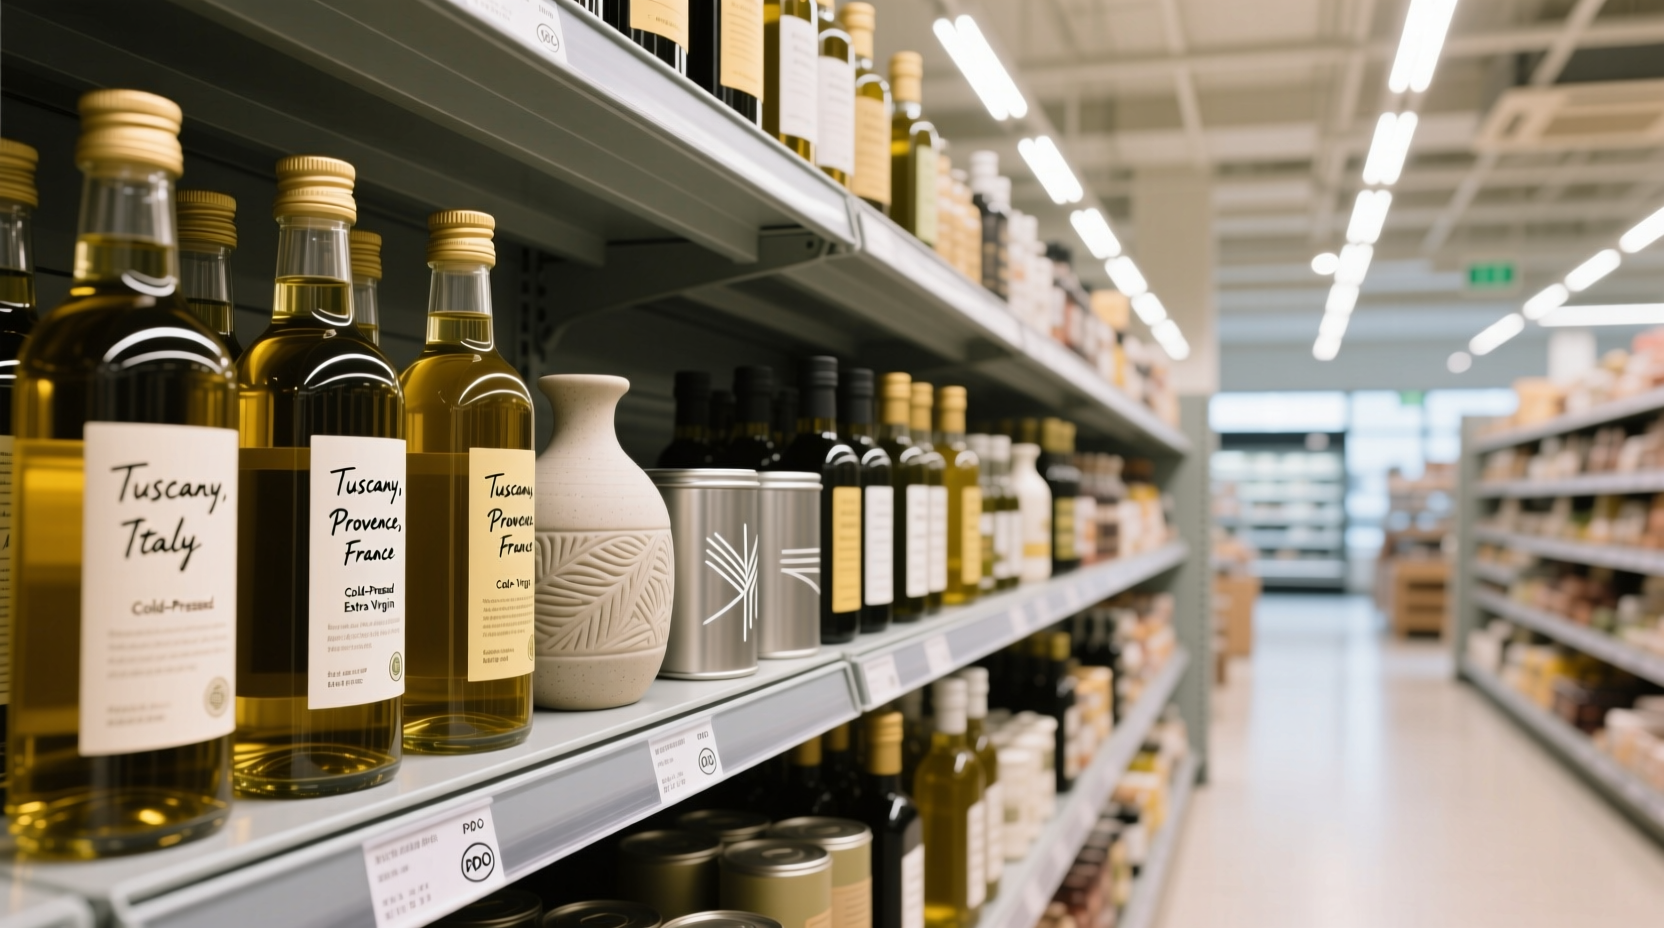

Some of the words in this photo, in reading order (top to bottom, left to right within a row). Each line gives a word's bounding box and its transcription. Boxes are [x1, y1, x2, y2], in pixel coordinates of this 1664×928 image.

[110, 462, 227, 515] Tuscany,
[329, 466, 402, 505] Tuscany,
[328, 507, 402, 536] Provence,
[343, 538, 396, 567] France
[462, 817, 485, 835] PDO
[465, 851, 492, 873] PDO
